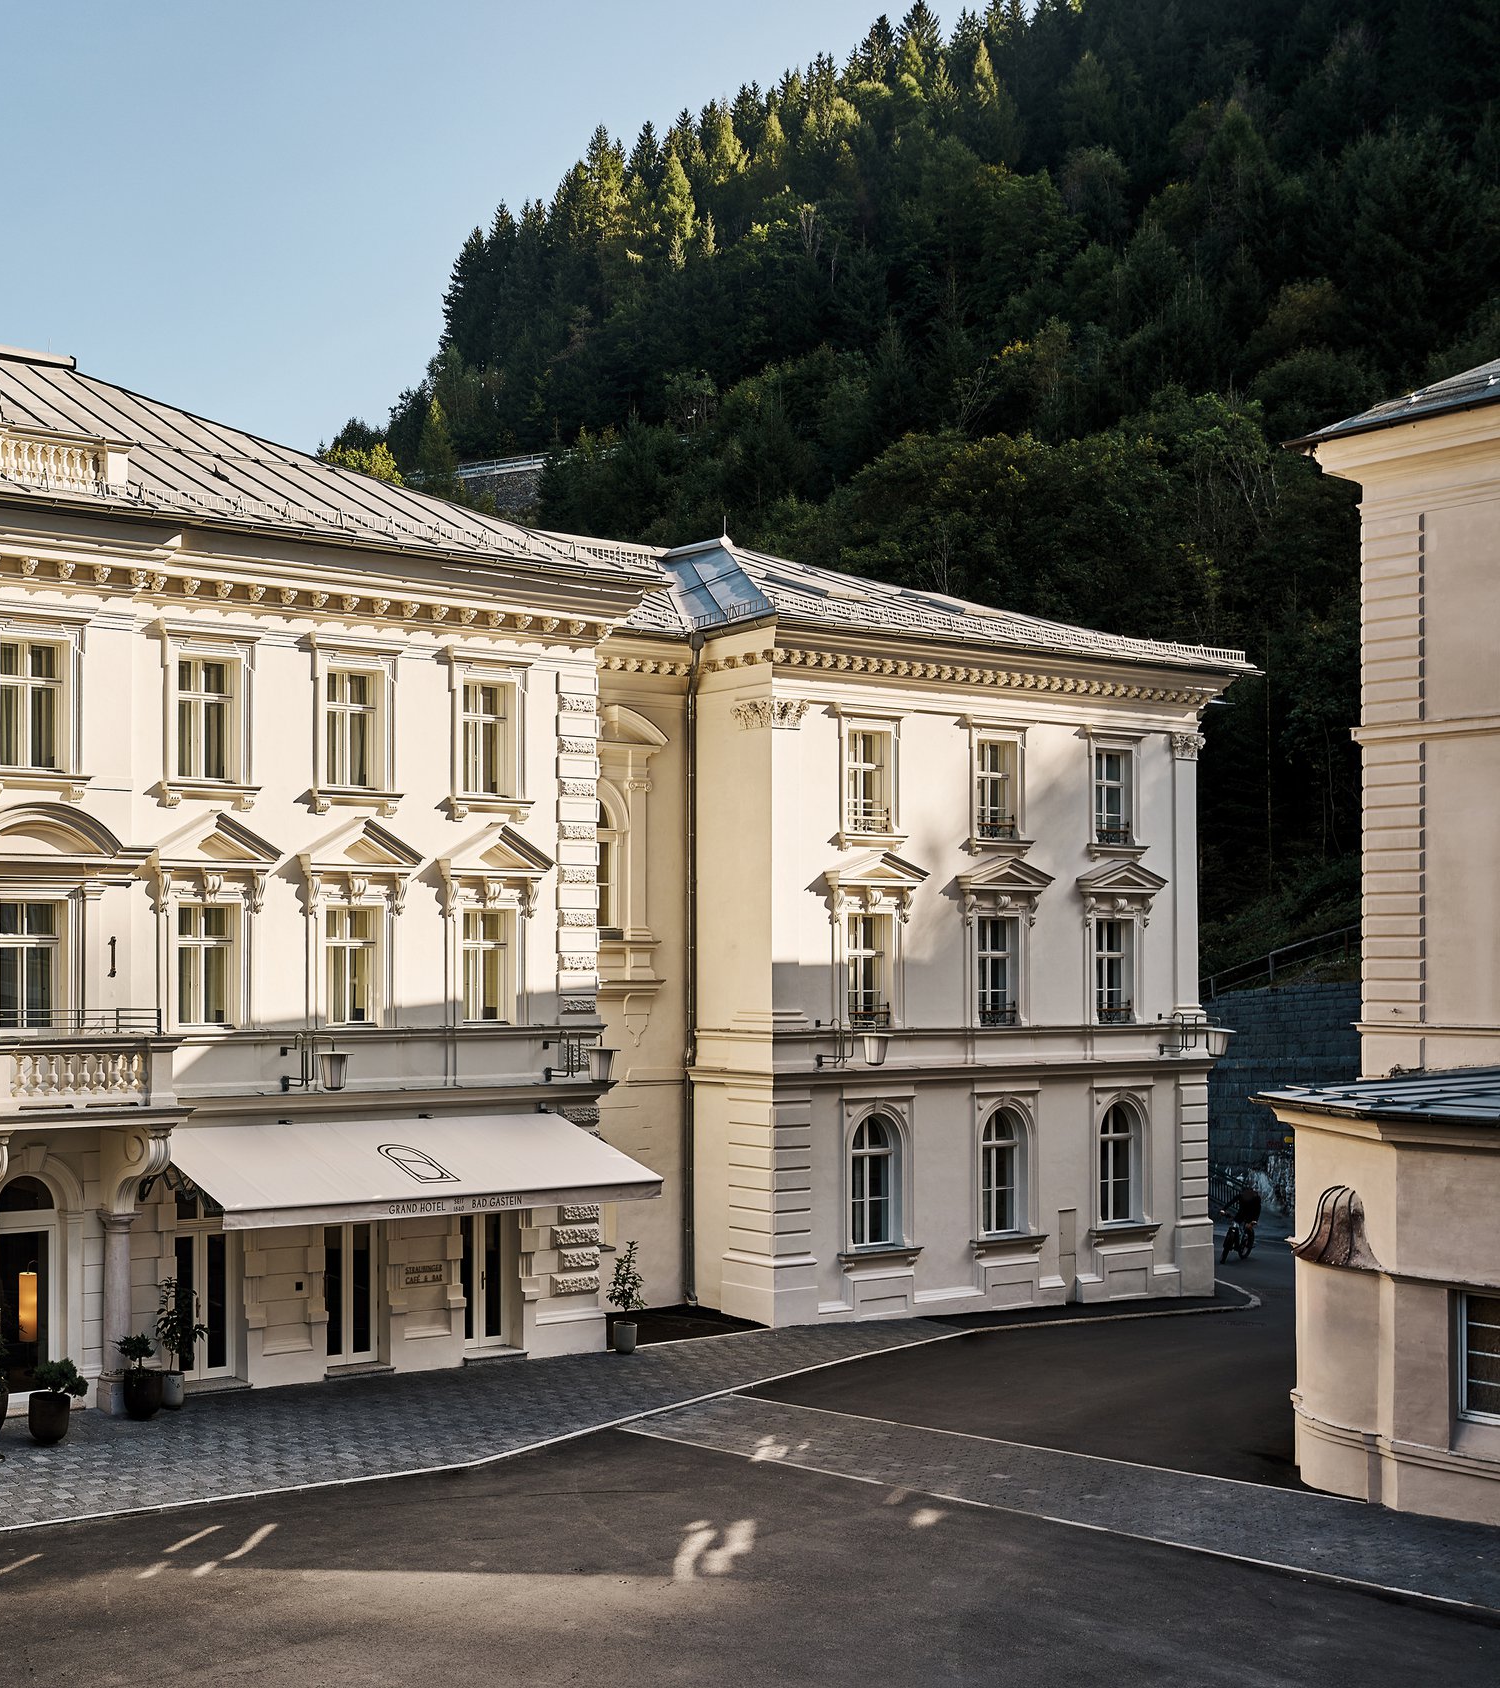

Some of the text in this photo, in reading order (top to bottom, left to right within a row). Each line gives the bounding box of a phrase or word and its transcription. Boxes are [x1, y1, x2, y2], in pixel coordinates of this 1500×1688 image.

[453, 1198, 465, 1206] SEIT
[471, 1195, 523, 1209] BAD GASTEIN
[388, 1201, 446, 1215] GRAND HOTEL
[453, 1205, 465, 1213] 1840
[405, 1274, 420, 1284] CAFÉ
